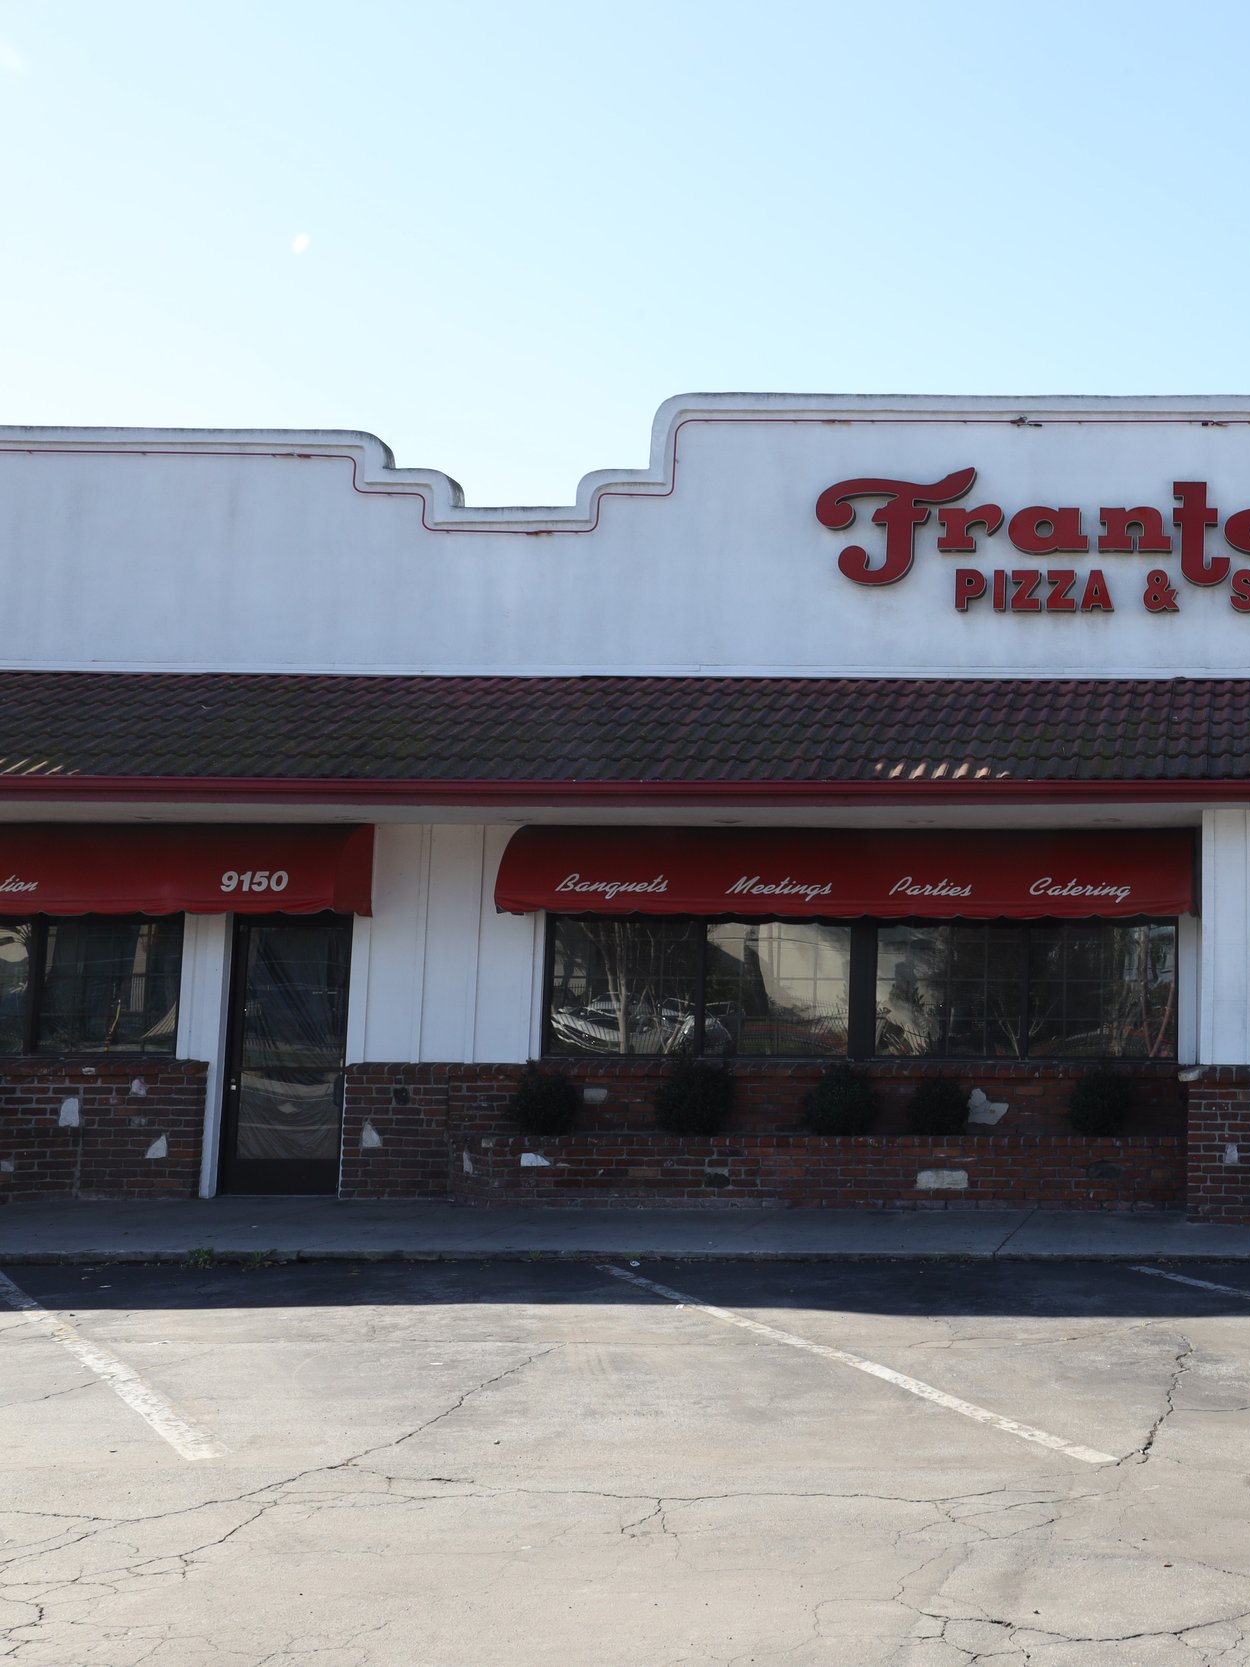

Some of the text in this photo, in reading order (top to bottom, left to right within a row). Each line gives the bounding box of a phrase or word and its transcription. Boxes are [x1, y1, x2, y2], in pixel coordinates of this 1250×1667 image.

[954, 569, 1114, 612] PIZZA
[1143, 569, 1180, 614] &
[220, 871, 288, 892] 9150
[555, 873, 1131, 902] Banquets Meetings Parties Catering
